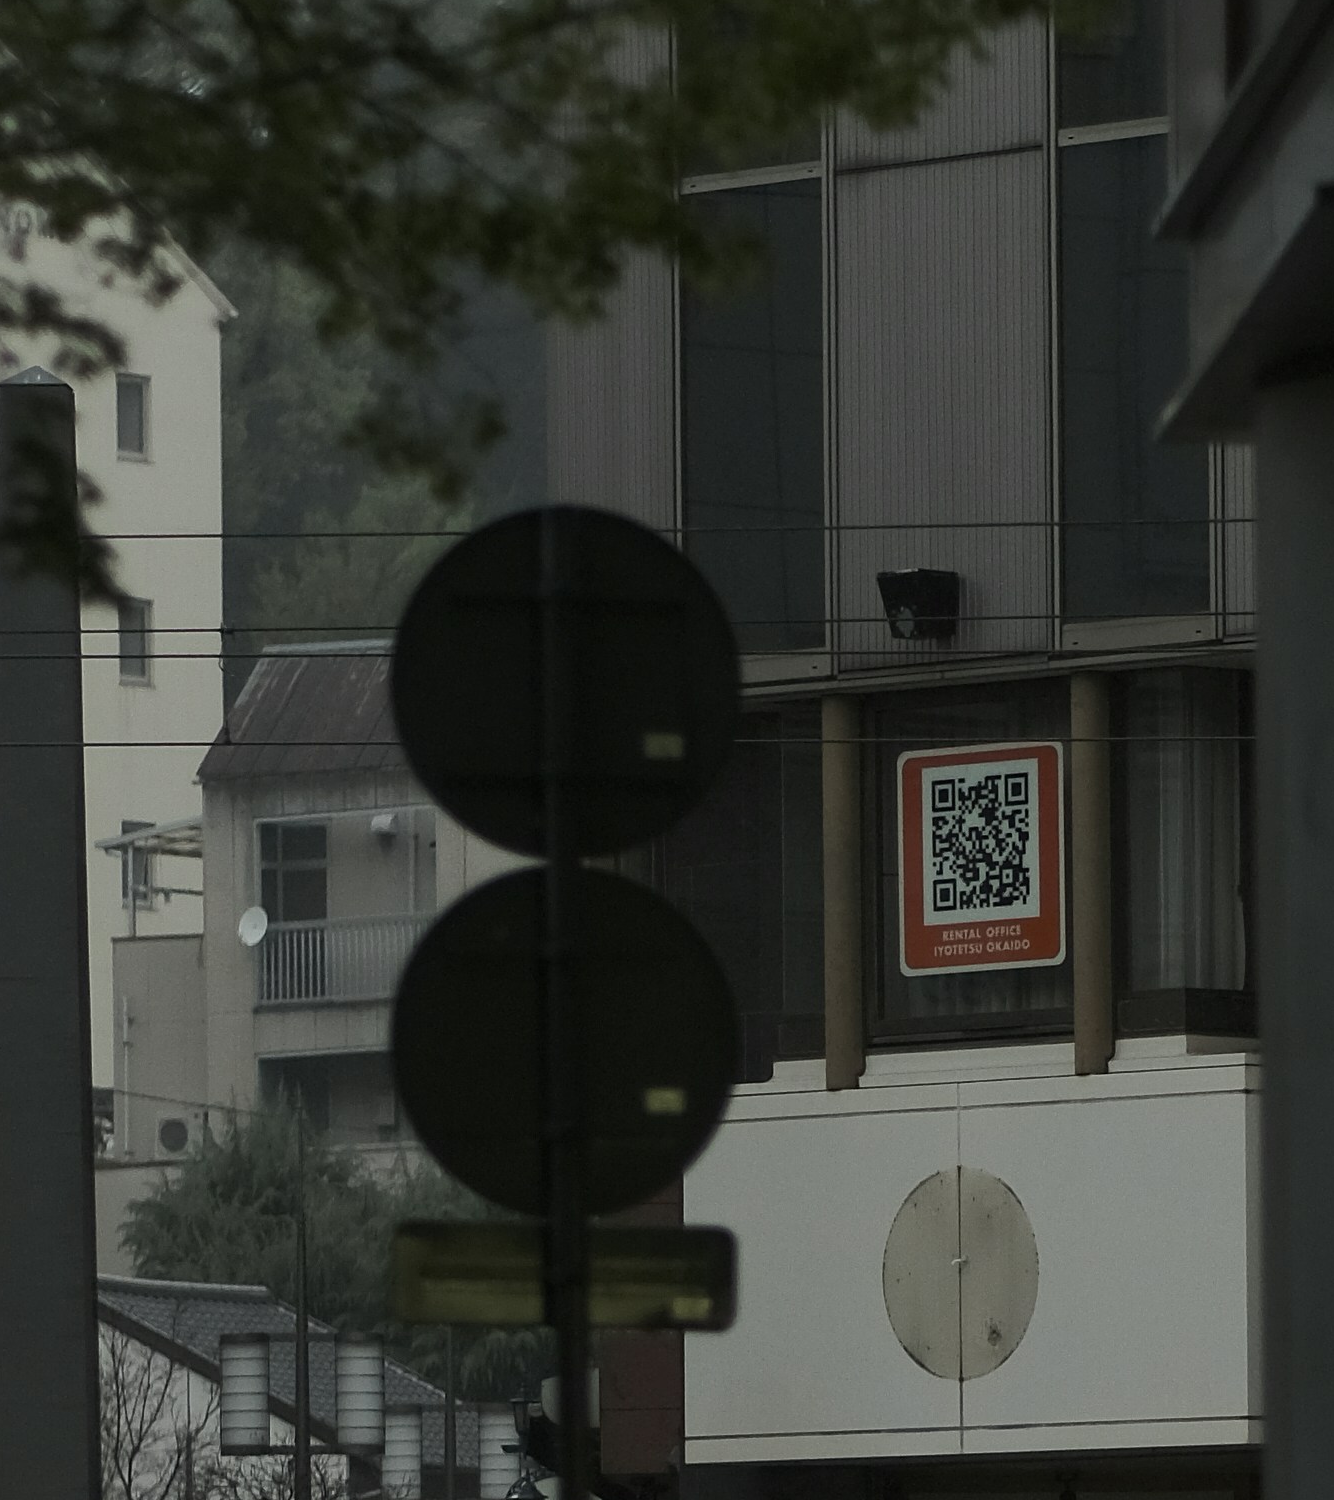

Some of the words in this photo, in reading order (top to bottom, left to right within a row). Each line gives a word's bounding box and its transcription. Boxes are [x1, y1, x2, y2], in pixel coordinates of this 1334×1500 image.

[942, 927, 982, 942] RENTAL
[986, 925, 1022, 939] OFFICE
[933, 942, 983, 958] IYOTETSU
[986, 939, 1031, 953] OKAIDO
